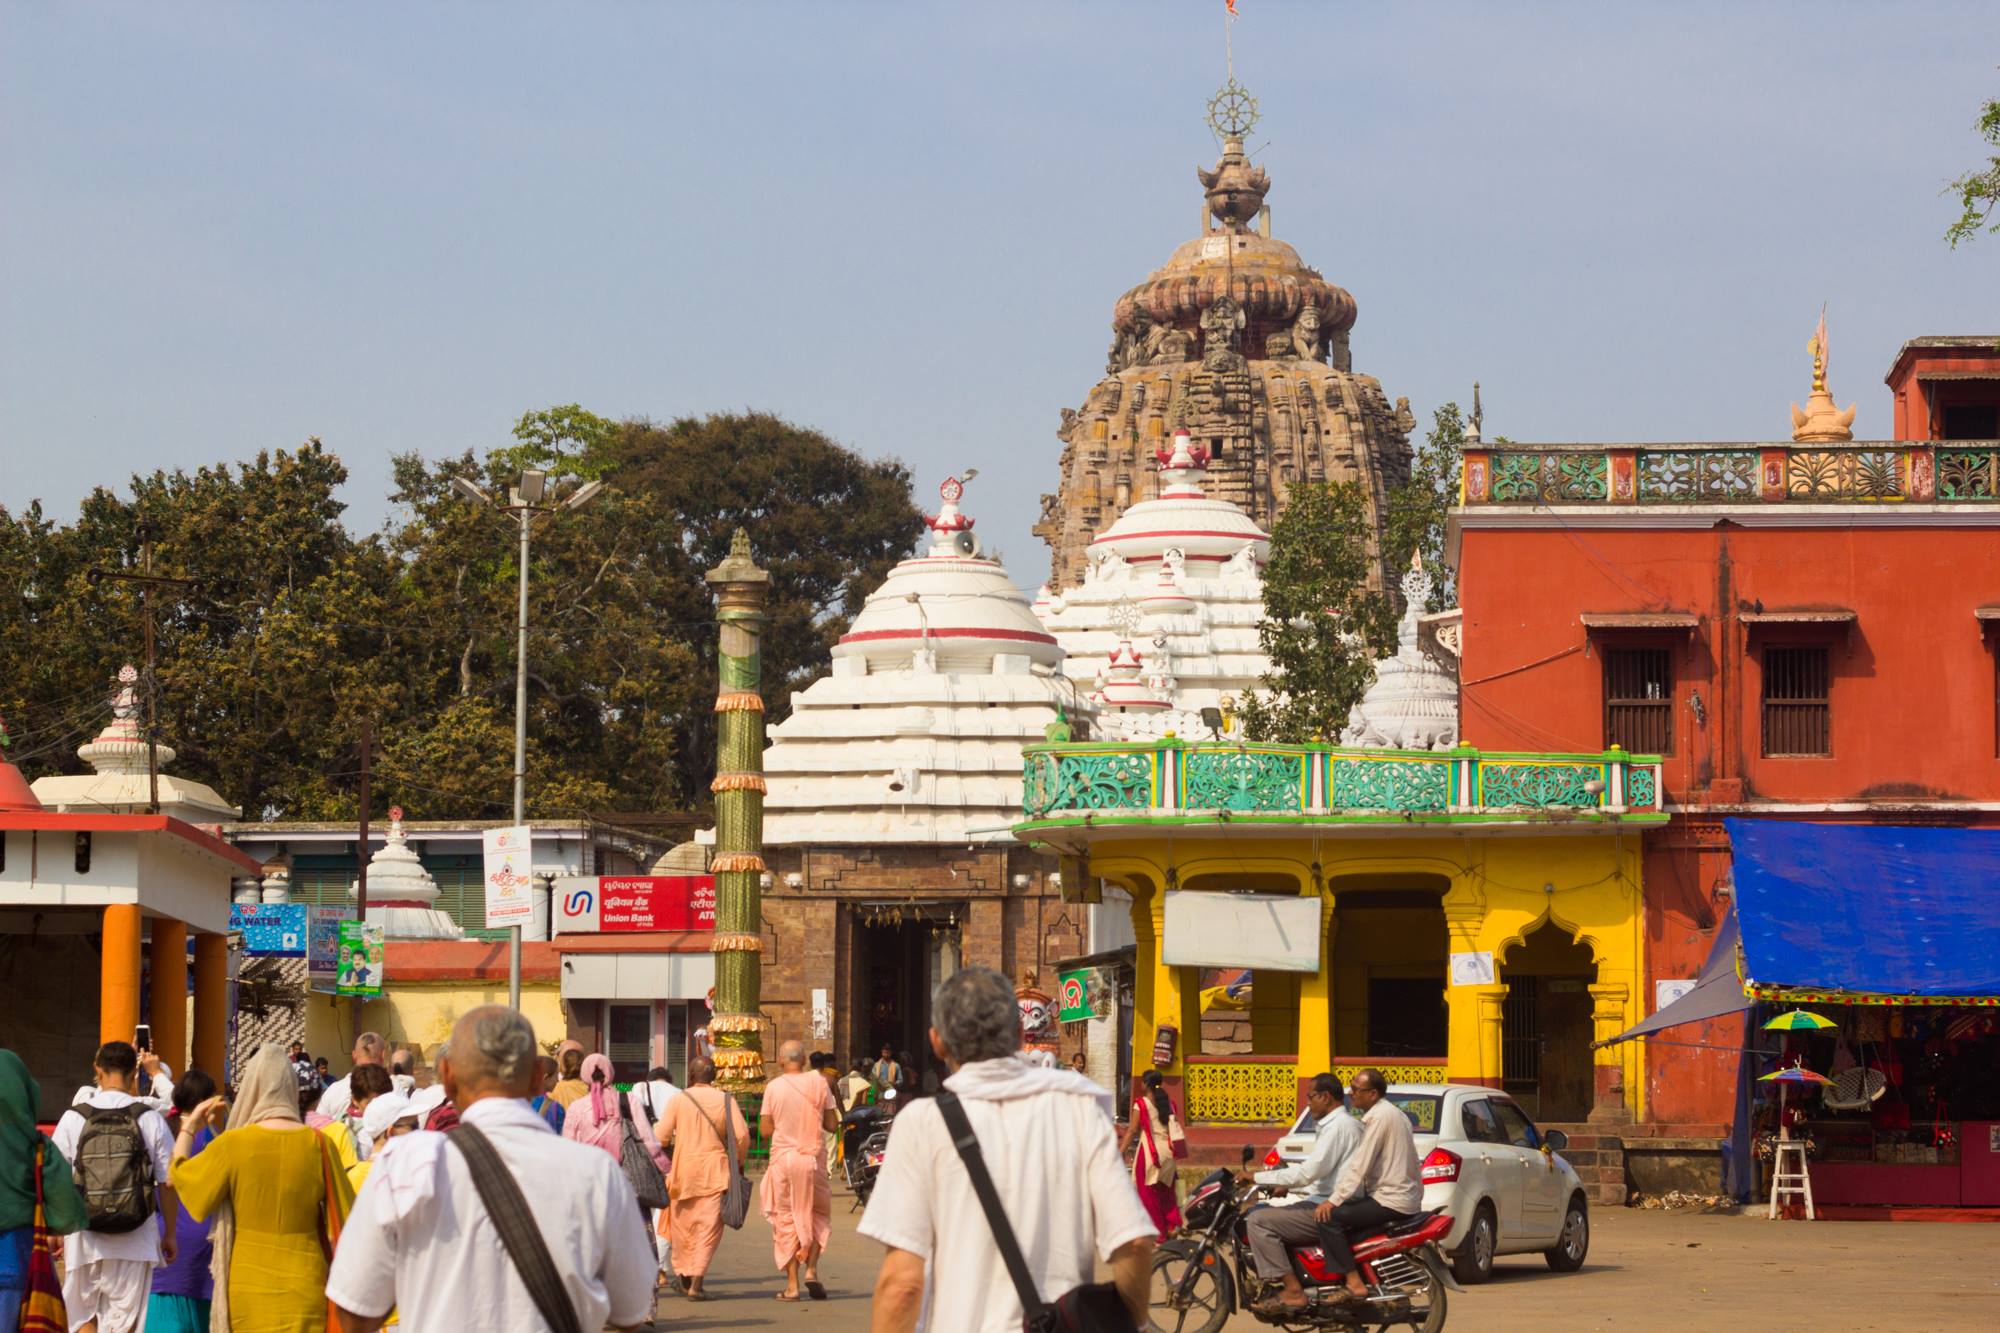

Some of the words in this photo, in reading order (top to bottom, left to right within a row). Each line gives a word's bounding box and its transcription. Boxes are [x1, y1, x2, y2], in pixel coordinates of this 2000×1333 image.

[245, 917, 282, 926] WATER
[604, 913, 630, 922] Union
[631, 913, 654, 922] Bank
